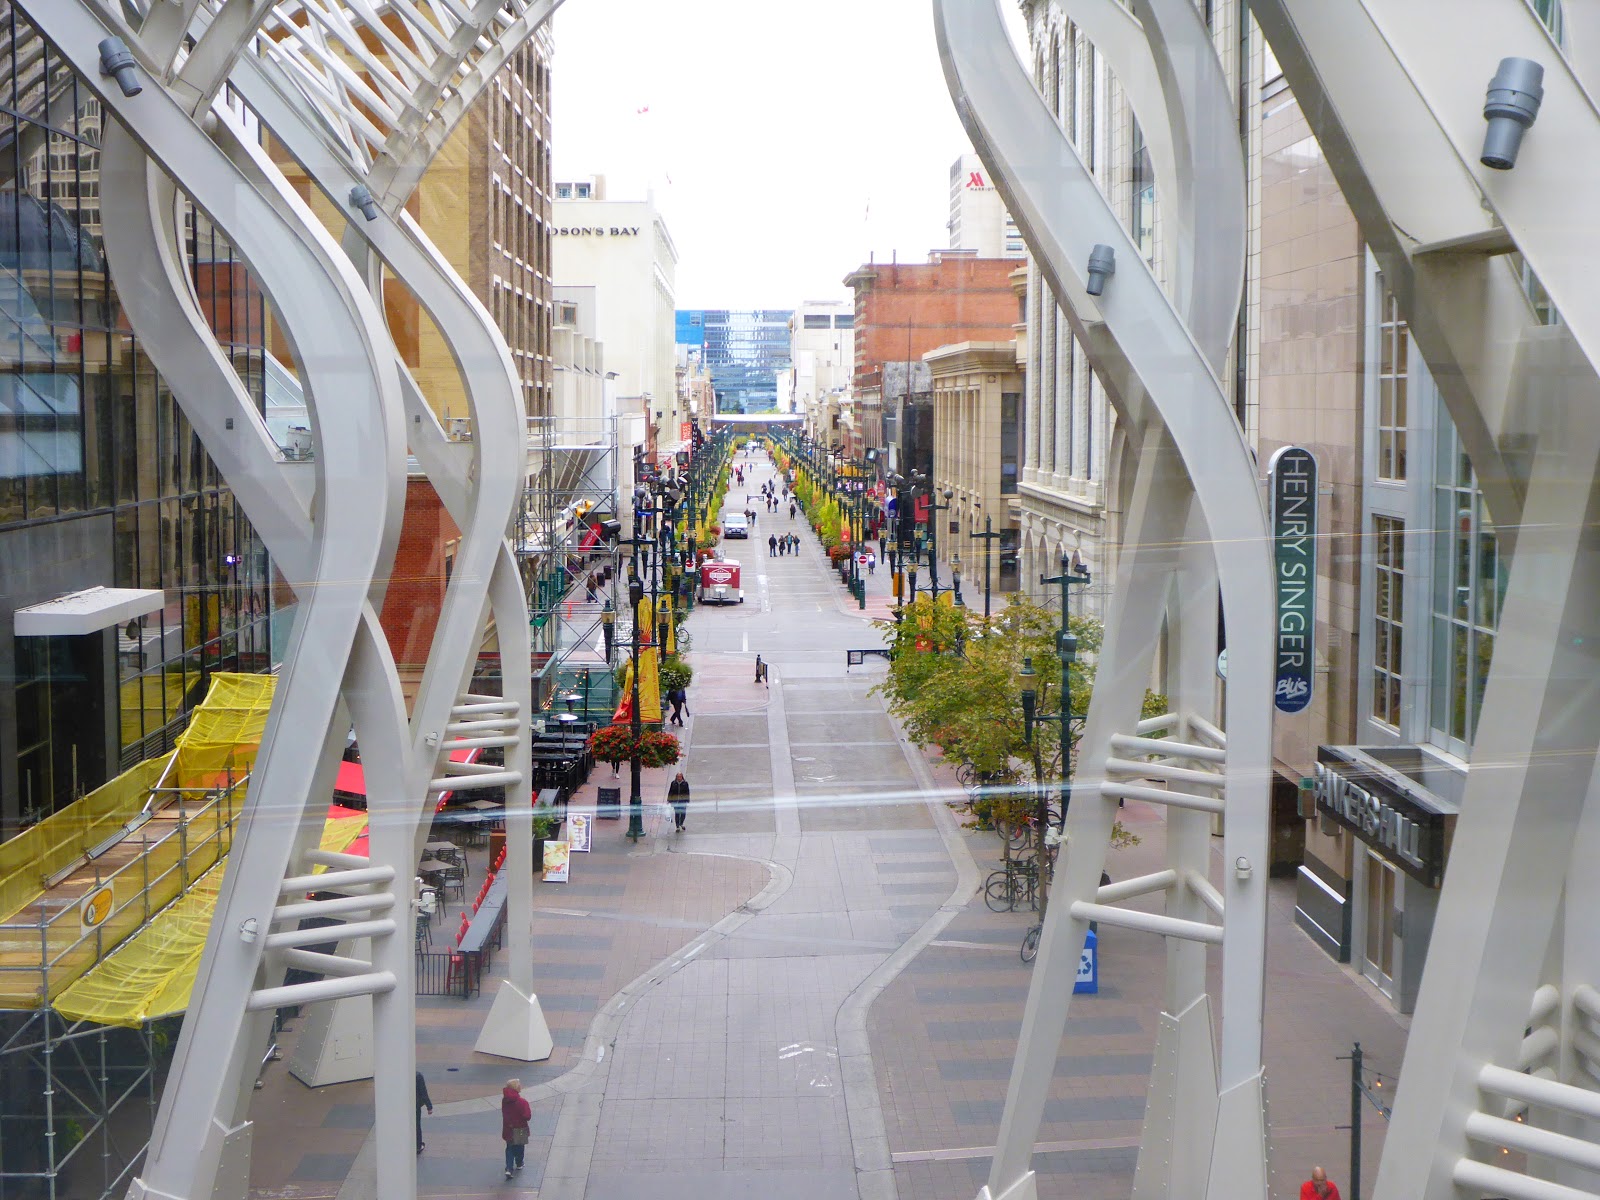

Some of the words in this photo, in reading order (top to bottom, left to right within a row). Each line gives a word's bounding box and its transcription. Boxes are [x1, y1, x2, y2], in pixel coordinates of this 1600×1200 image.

[610, 227, 640, 236] BAY
[1282, 456, 1308, 556] HENRY
[1280, 562, 1307, 668] SINGER
[1313, 761, 1380, 836] BANKERS
[1379, 803, 1425, 869] HALL
